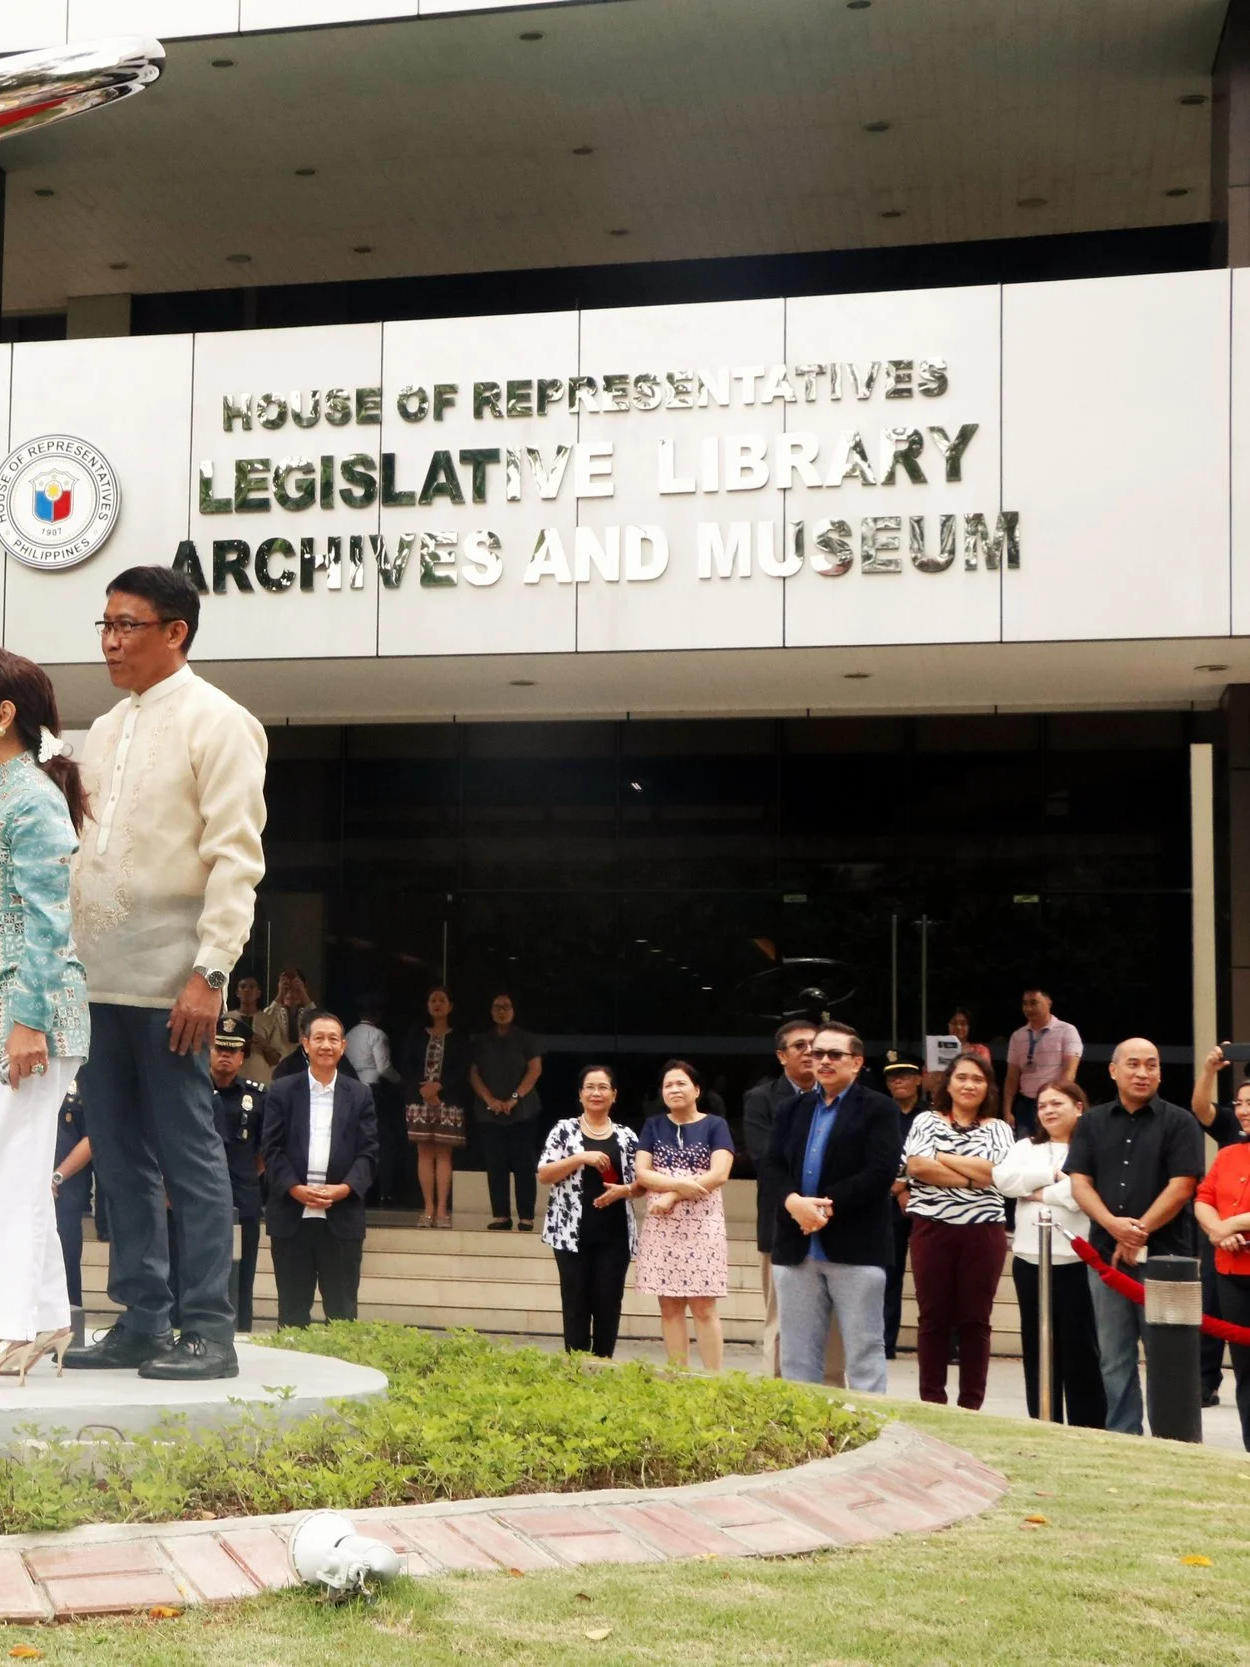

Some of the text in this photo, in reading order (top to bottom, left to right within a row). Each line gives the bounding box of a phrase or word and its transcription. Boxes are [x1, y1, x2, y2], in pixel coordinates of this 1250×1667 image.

[222, 356, 948, 432] HOUSE OF REPRESENTATIVES
[9, 455, 25, 472] OF
[28, 440, 112, 522] REPRESENTATIVES
[199, 423, 979, 514] LEGISLATIVE LIBRARY
[13, 538, 91, 561] PHILIPPINES
[171, 511, 1020, 595] ARCHIVES AND MUSEUM
